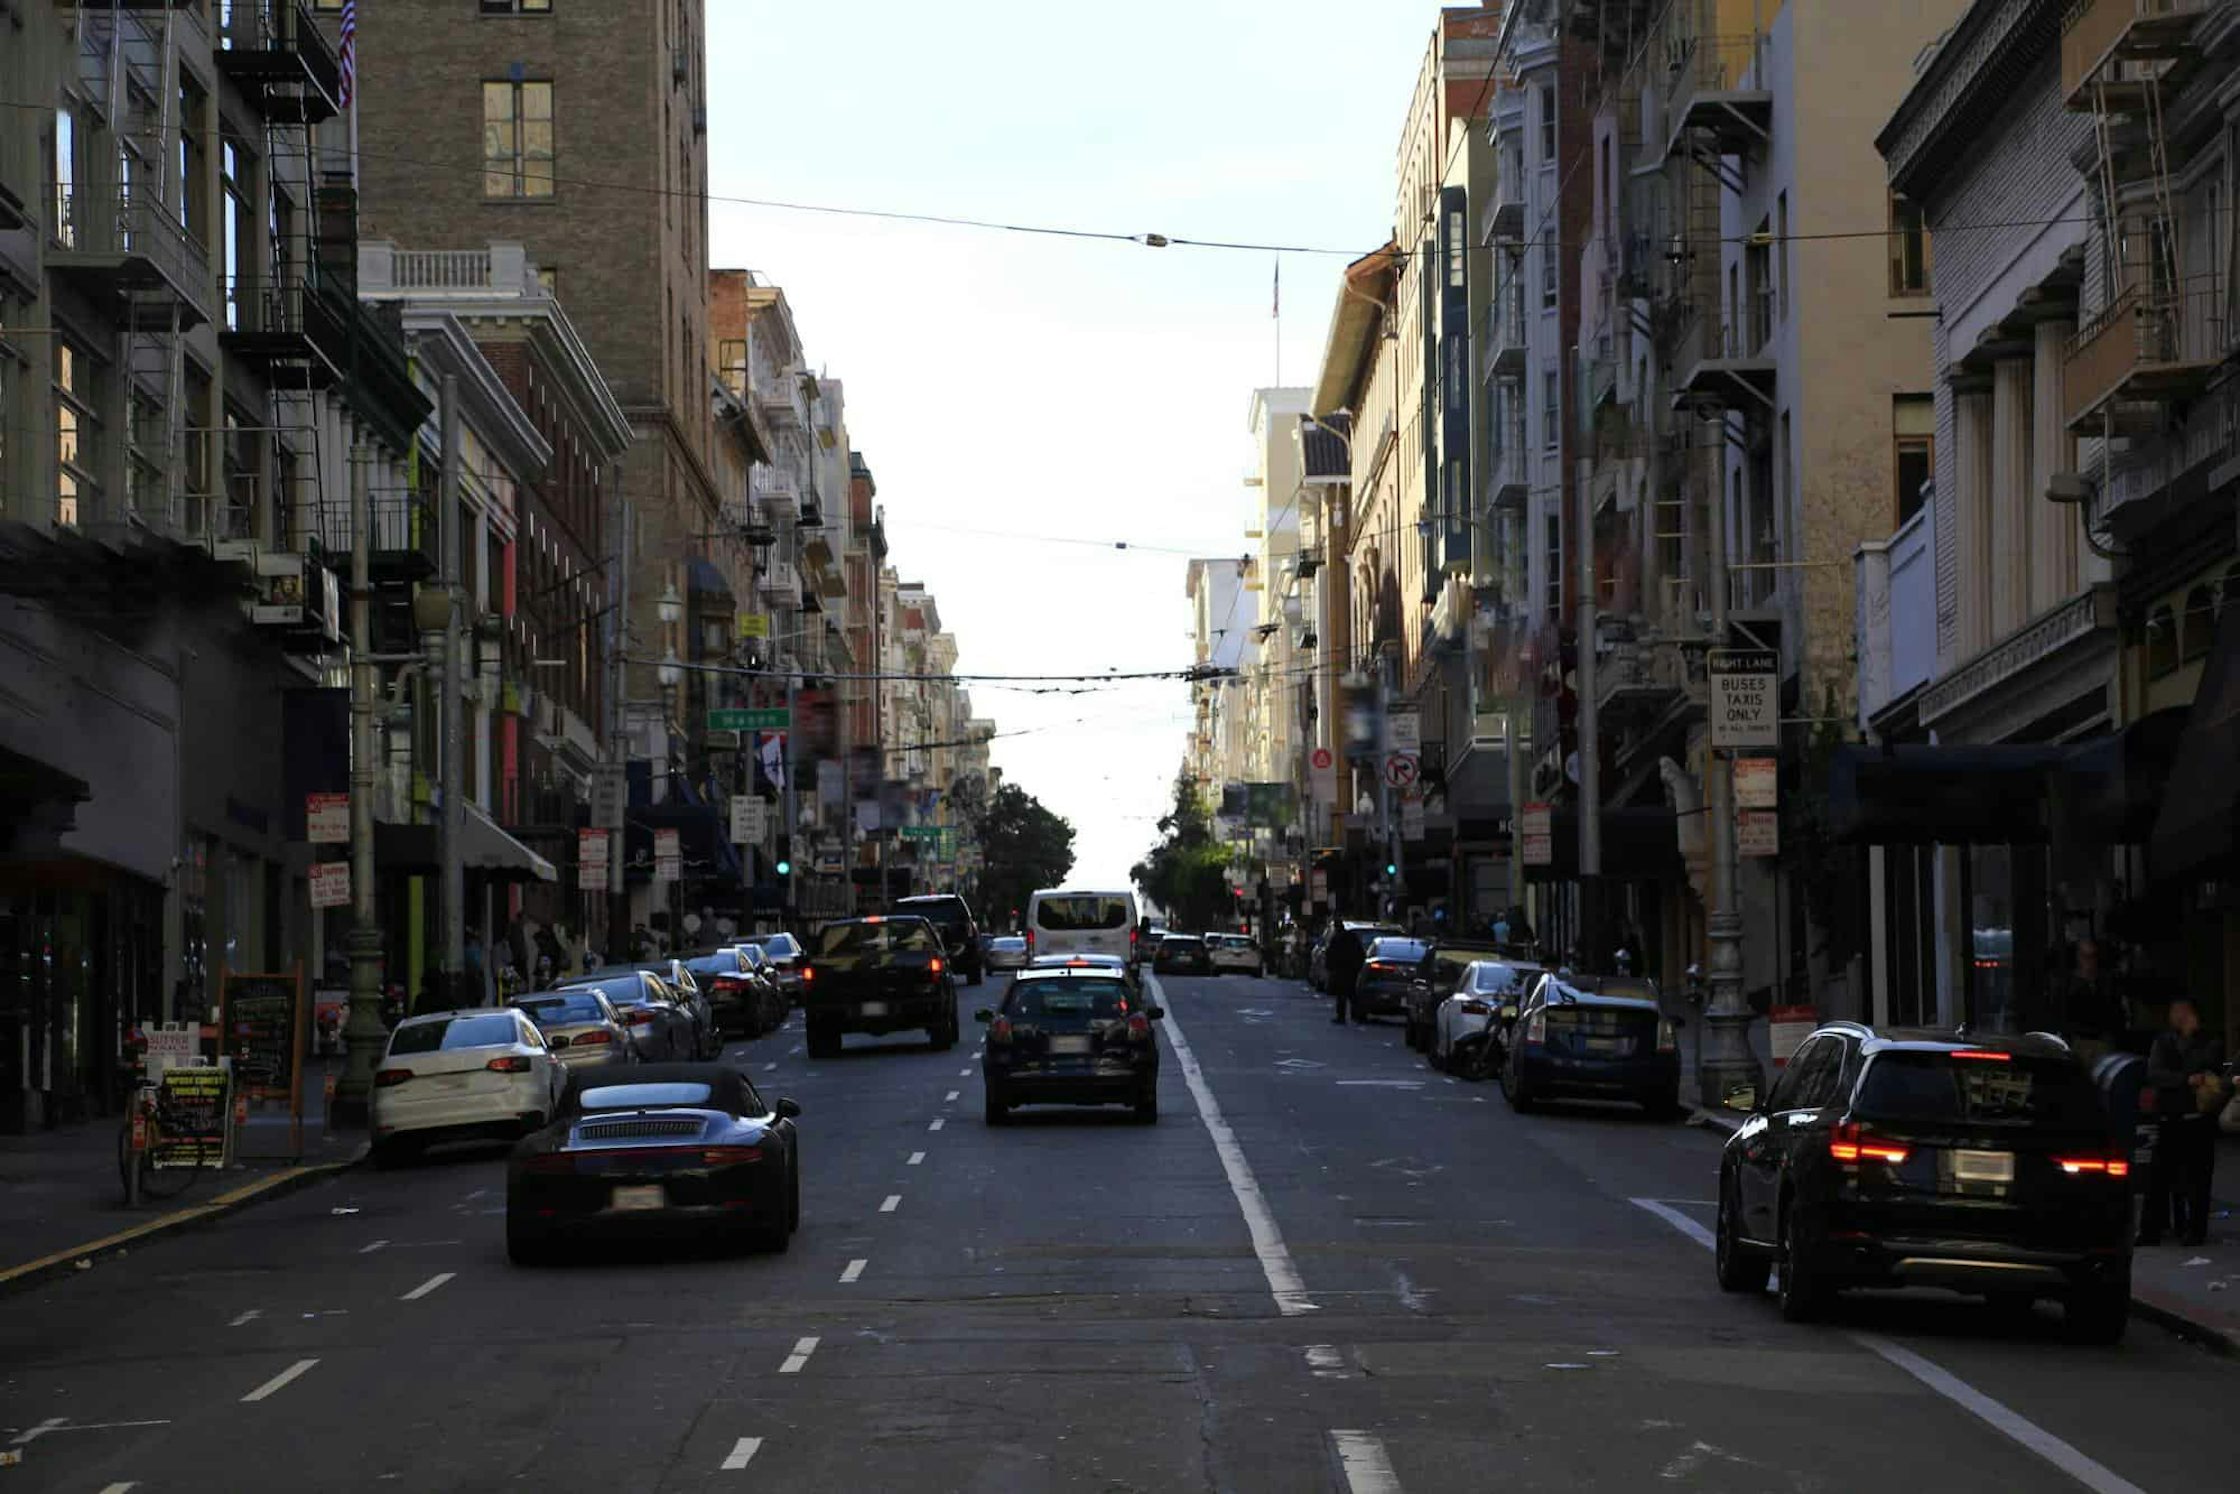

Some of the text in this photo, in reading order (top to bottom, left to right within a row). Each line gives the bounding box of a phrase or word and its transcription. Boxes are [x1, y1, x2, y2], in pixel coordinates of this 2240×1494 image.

[1745, 657, 1775, 669] LANE
[1721, 678, 1766, 691] BUSES
[1726, 694, 1763, 706] TAXIS
[1727, 709, 1760, 721] ONLY
